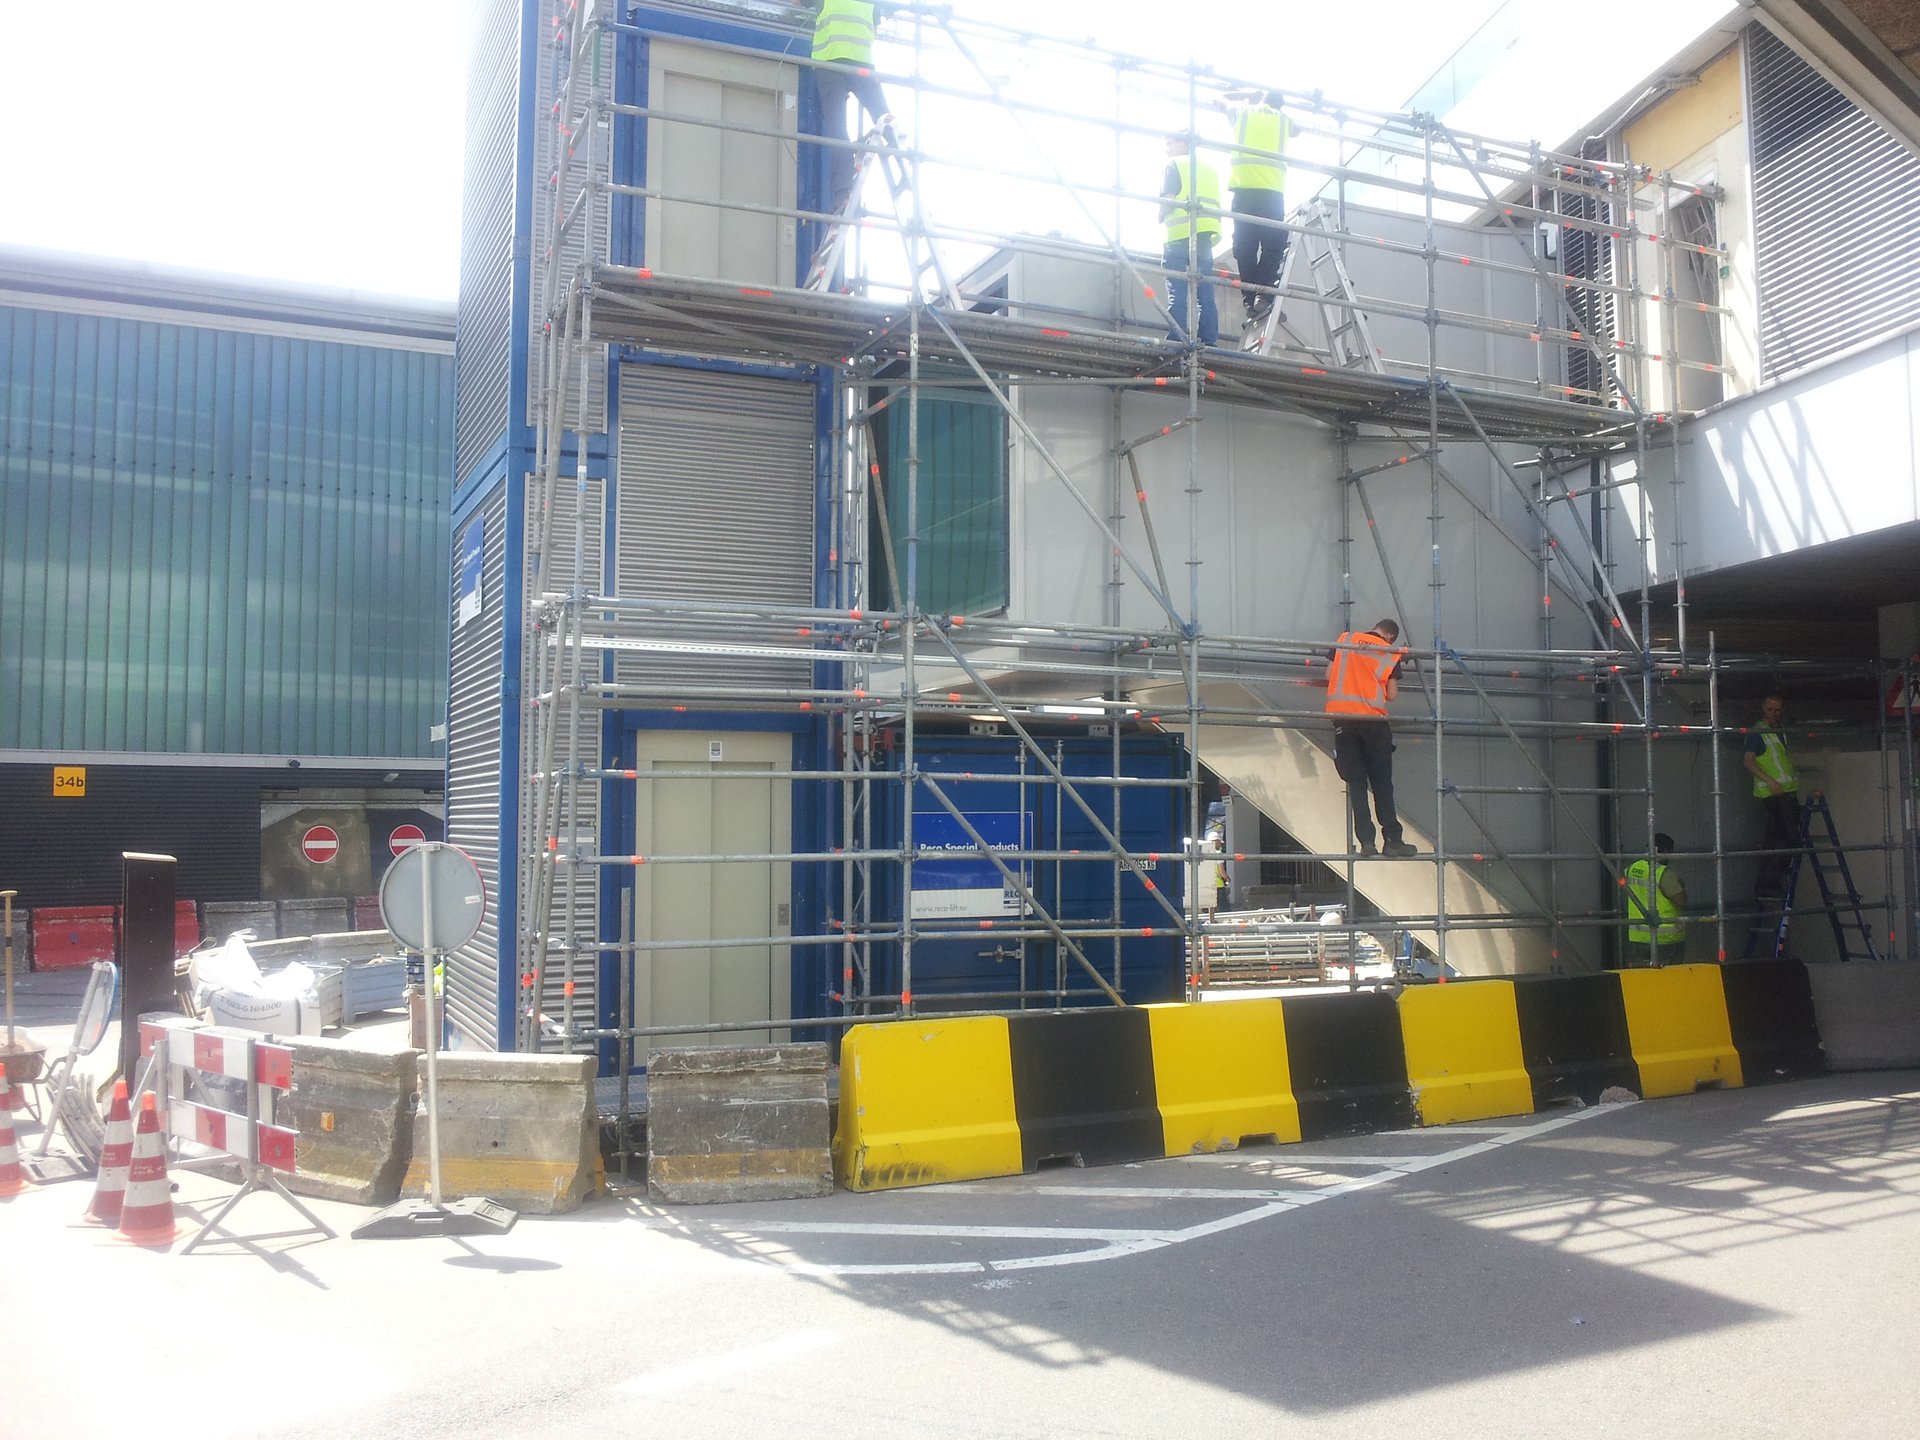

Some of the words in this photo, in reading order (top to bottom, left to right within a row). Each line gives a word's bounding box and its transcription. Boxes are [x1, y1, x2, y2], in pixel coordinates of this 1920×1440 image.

[55, 776, 84, 787] 34b
[945, 842, 978, 850] Special
[1004, 890, 1020, 898] REC
[915, 903, 967, 913] www.reco-lift.eu
